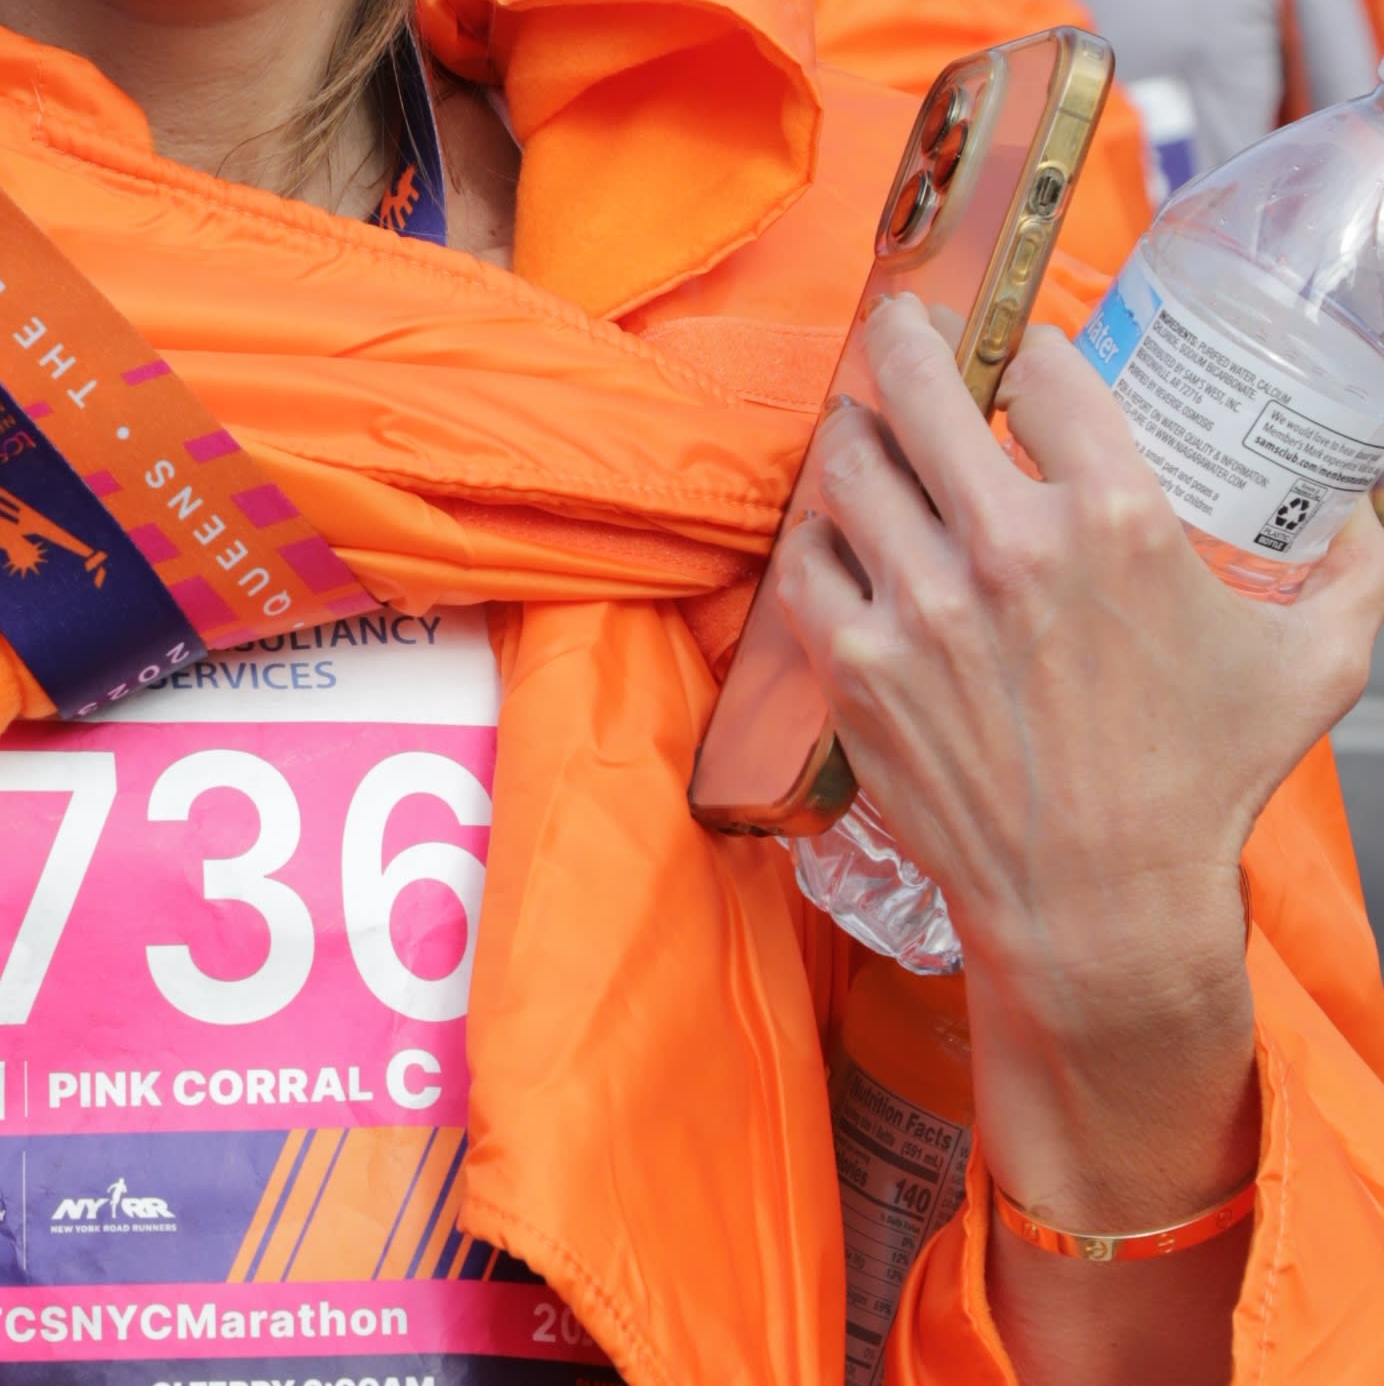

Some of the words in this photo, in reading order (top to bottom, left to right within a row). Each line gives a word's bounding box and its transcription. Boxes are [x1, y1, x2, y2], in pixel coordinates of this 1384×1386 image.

[13, 316, 97, 409] THE
[1088, 310, 1120, 367] ater
[145, 459, 292, 617] QUEENS
[48, 1069, 162, 1109] PINK
[173, 1065, 373, 1106] CORRAL
[384, 1048, 444, 1110] C
[849, 1073, 904, 1127] Nutrition
[906, 1112, 953, 1151] Facts
[894, 1178, 933, 1214] 140
[50, 1225, 72, 1234] NEW
[74, 1224, 101, 1234] YORK
[103, 1224, 130, 1233] ROAD
[132, 1223, 177, 1233] RUNNERS
